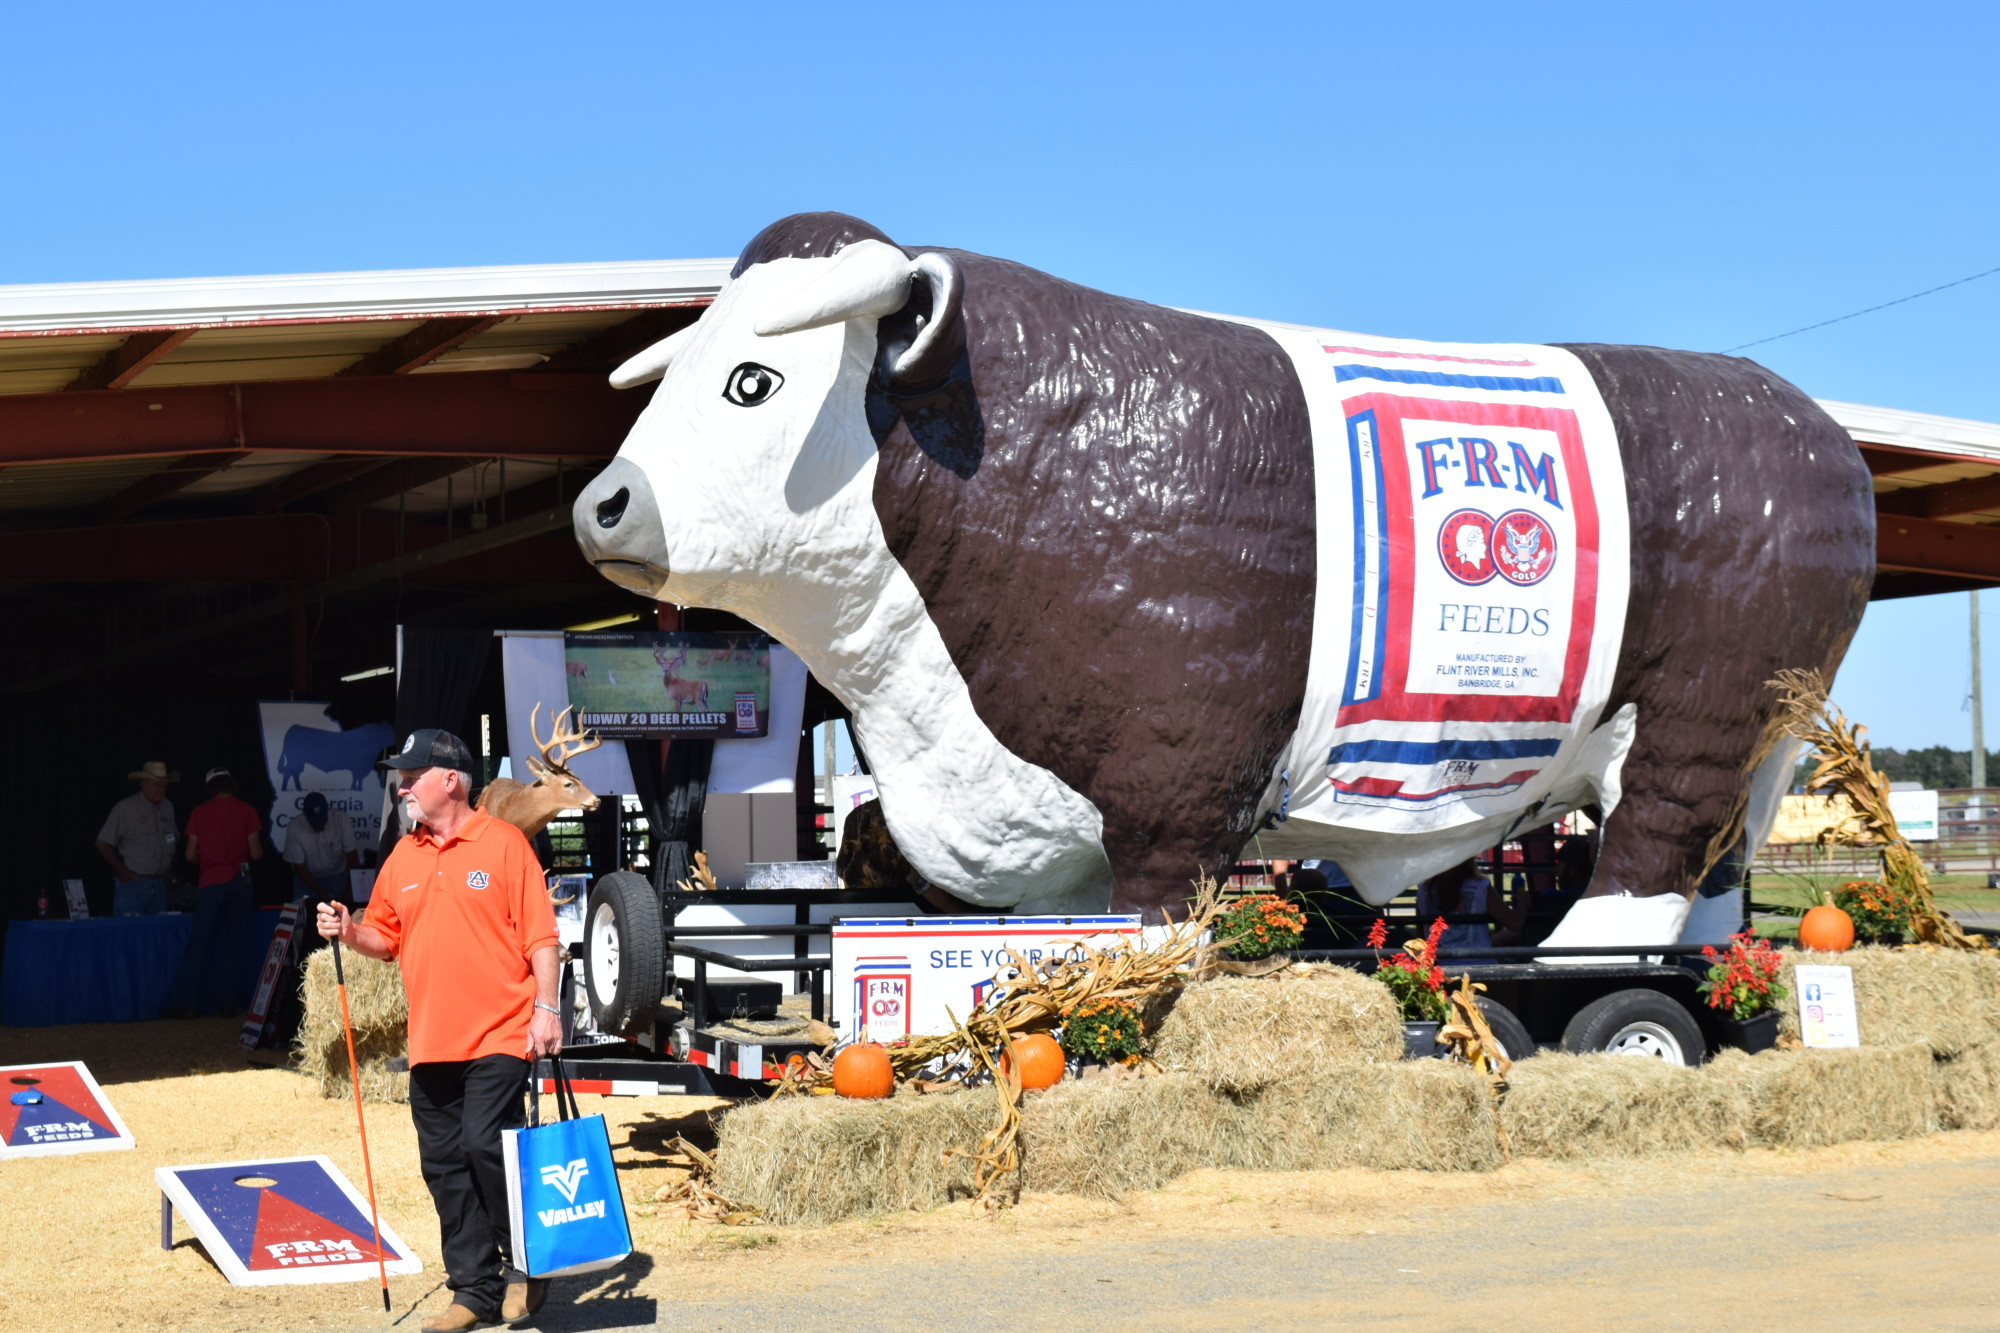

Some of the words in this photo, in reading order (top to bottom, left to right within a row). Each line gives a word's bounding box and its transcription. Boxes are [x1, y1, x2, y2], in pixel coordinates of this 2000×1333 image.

[1415, 437, 1564, 511] F-R-M
[1511, 571, 1537, 580] GOLD
[1437, 603, 1550, 637] FEEDS
[1455, 653, 1514, 663] MANUFACTURED
[1515, 655, 1526, 664] BY
[1436, 664, 1463, 675] FLINT
[1464, 665, 1490, 676] RIVER
[1491, 666, 1519, 678] MILLS,
[1521, 667, 1539, 678] INC.
[1504, 680, 1515, 688] GA
[631, 713, 647, 725] 20
[650, 713, 680, 725] DEER
[682, 713, 727, 725] PELLETS
[294, 796, 364, 813] Grgia
[930, 949, 973, 969] SEE
[32, 1131, 94, 1143] FEEDS
[537, 1200, 605, 1228] VALLEY
[265, 1239, 361, 1259] F-R-M
[279, 1252, 363, 1266] FEEDS
